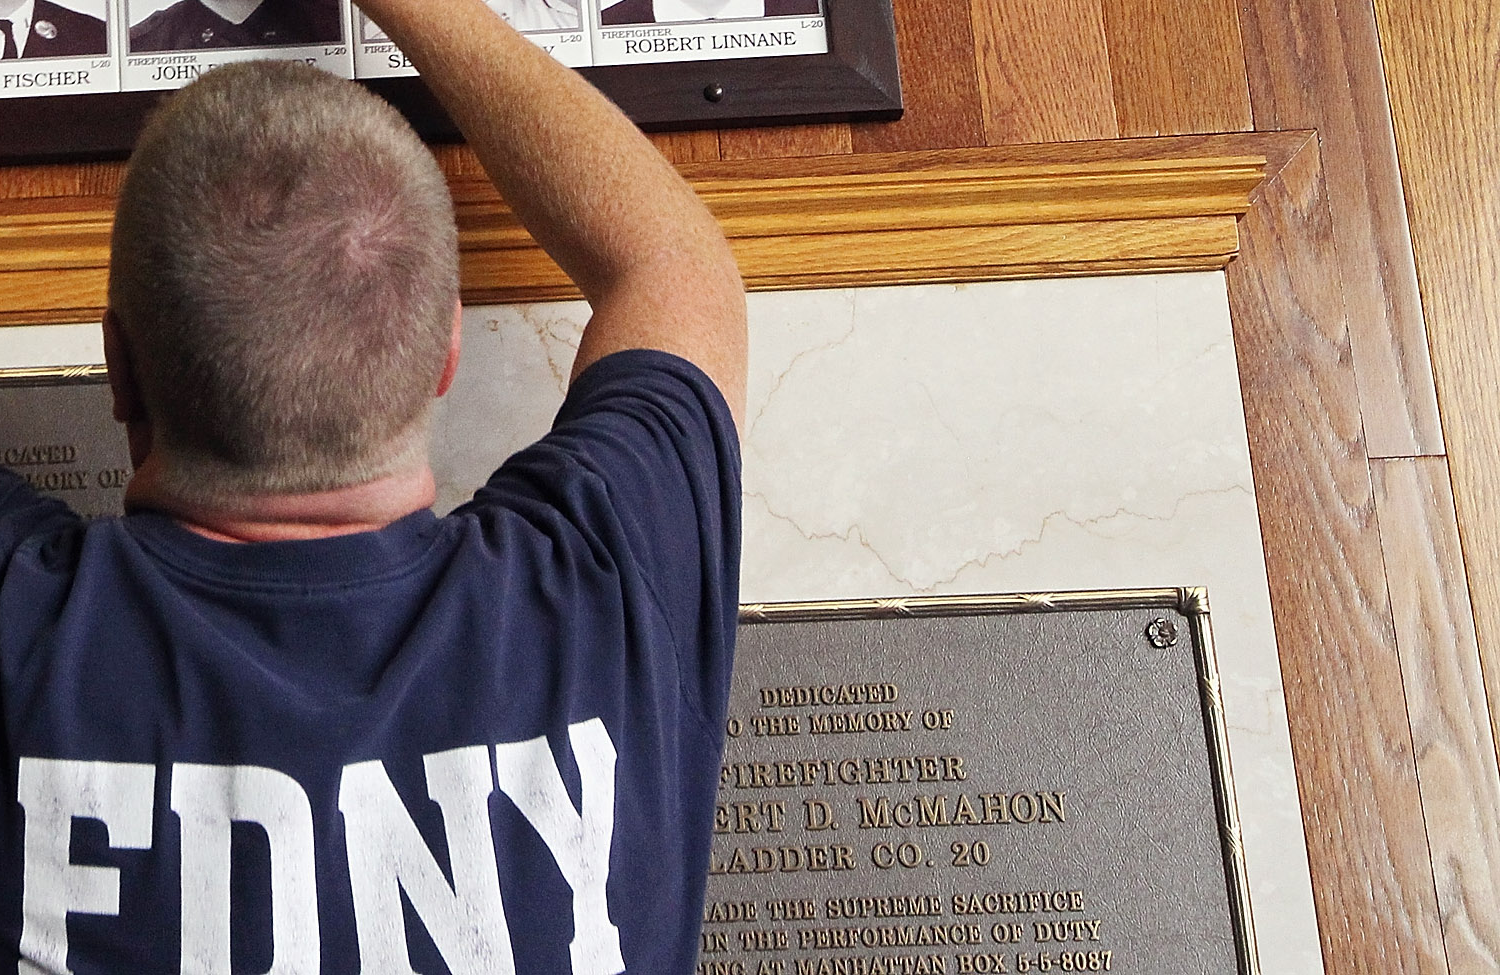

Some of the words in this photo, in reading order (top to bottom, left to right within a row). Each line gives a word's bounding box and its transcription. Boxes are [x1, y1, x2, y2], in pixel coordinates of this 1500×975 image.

[601, 28, 672, 39] FIREFIGHTER
[801, 20, 824, 29] L-20
[560, 34, 583, 43] L-20
[625, 36, 705, 54] ROBERT
[712, 31, 797, 50] LINNANE
[127, 55, 197, 66] FIREFIGHTER
[324, 47, 347, 56] L-20
[91, 60, 111, 69] L-20
[152, 64, 202, 80] JOHN
[3, 70, 90, 89] FISCHER
[97, 468, 127, 488] OF
[760, 683, 899, 707] DEDICATED
[727, 718, 743, 737] O
[752, 714, 800, 736] THE
[810, 710, 913, 734] MEMORY
[922, 709, 955, 730] OF
[804, 799, 839, 831] D.
[857, 791, 1067, 829] McMAHON
[17, 717, 625, 975] FDNY
[709, 843, 856, 875] LADDER
[871, 841, 935, 869] CO.
[951, 841, 992, 868] 20
[703, 899, 757, 923] ADE
[766, 899, 817, 921] THE
[826, 895, 943, 919] SUPREME
[952, 890, 1085, 915] SACRIFICE
[702, 932, 729, 953] IN
[738, 929, 789, 951] THE
[797, 924, 982, 949] PERFORMANCE
[992, 923, 1024, 943] OF
[1034, 920, 1101, 943] DUTY
[757, 959, 785, 975] AT
[794, 954, 947, 975] MANHATTAN
[956, 953, 1008, 974] BOX
[1017, 950, 1113, 974] 5-5-8087
